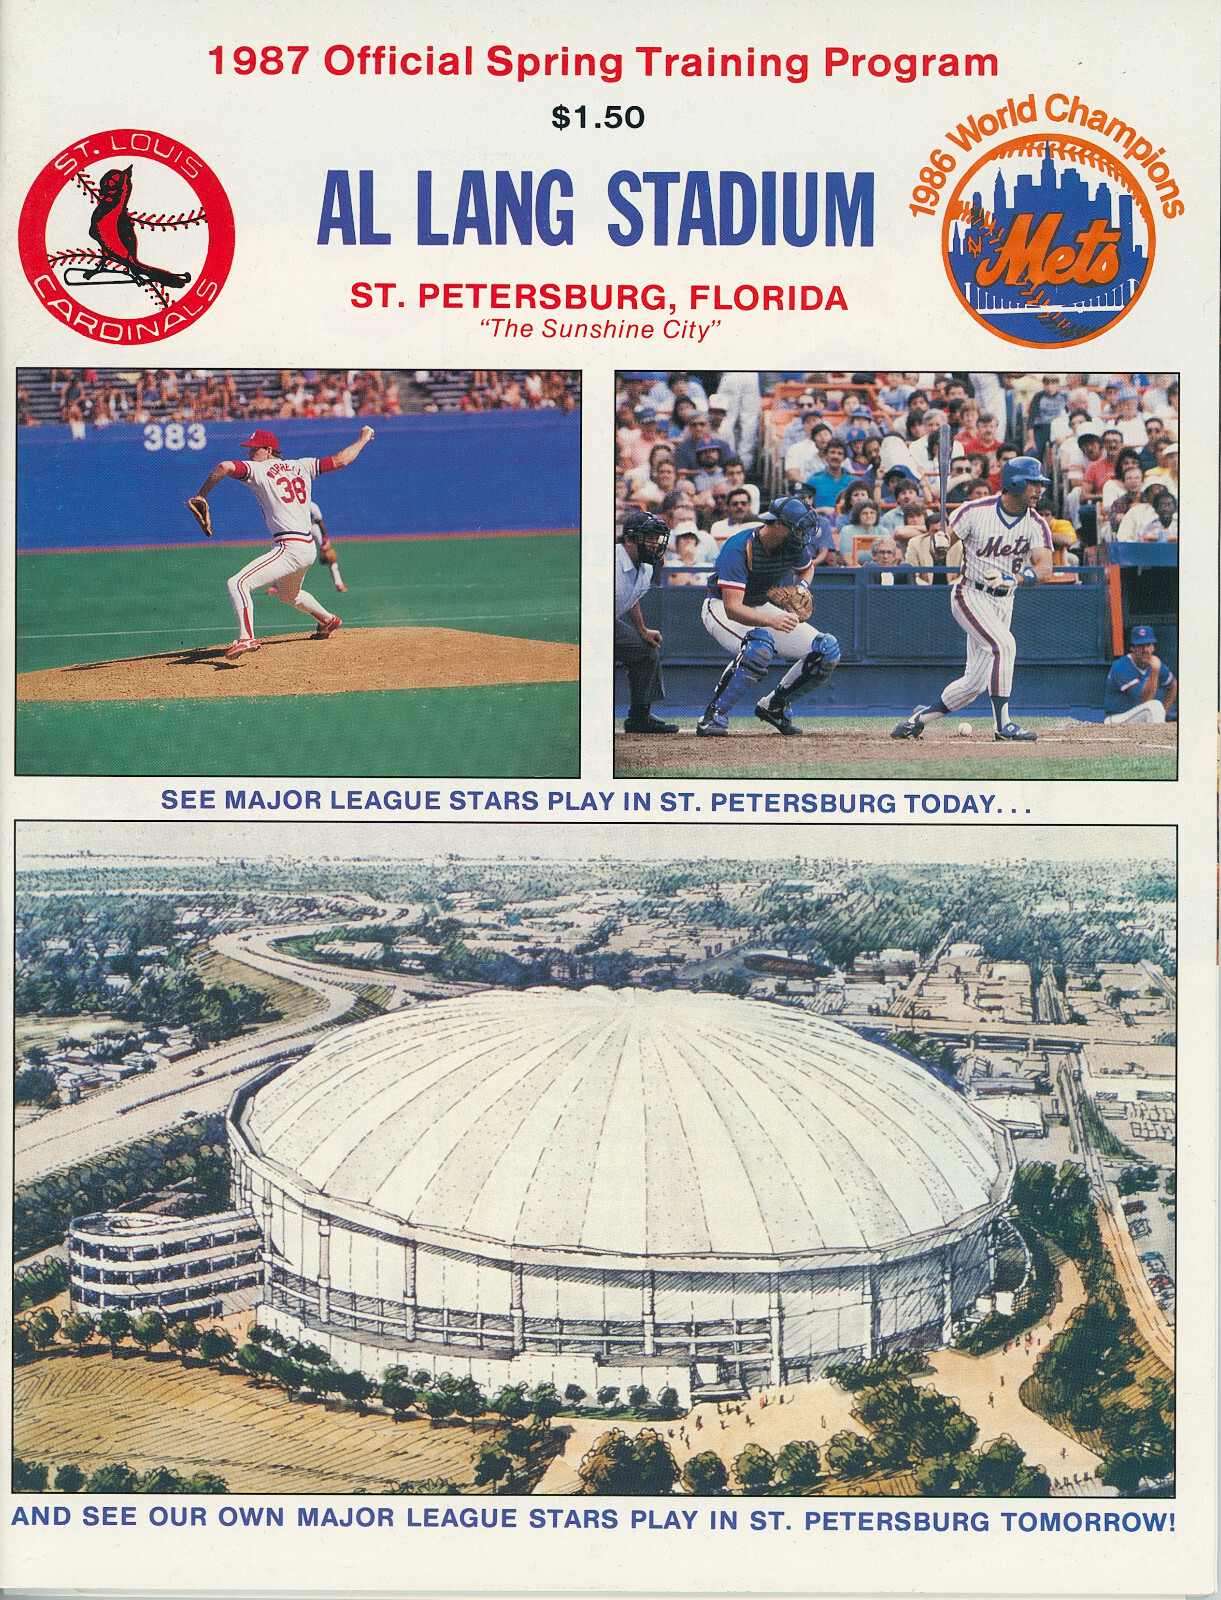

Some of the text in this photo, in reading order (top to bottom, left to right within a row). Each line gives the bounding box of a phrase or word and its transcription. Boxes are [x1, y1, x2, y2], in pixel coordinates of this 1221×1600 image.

[208, 43, 999, 84] 1987 Official Spring Training Program
[551, 104, 645, 130] $1.50
[54, 133, 203, 179] ST. LOUIS
[908, 92, 1185, 220] 1986 World Champions
[316, 169, 875, 248] AL LANG STADIUM
[973, 212, 1122, 288] Mets
[33, 274, 218, 342] CARDINALS
[350, 282, 849, 316] ST. PETERSBURG, FLORIDA
[541, 318, 655, 339] Sunshine
[143, 422, 207, 452] 383
[276, 476, 307, 505] 38
[975, 535, 1031, 558] Mets
[161, 790, 216, 810] SEE
[225, 790, 322, 810] MAJOR
[331, 790, 441, 811] LEAGUE
[449, 790, 539, 811] STARS
[548, 791, 616, 811] PLAY
[624, 791, 651, 812] IN
[660, 791, 701, 812] ST.
[711, 792, 896, 814] PETERSBURG
[10, 1505, 1176, 1533] AND SEE OUR OWN MAJOR LEAGUE STARS PLAY IN ST. PETERSBURG TOMORROW!
